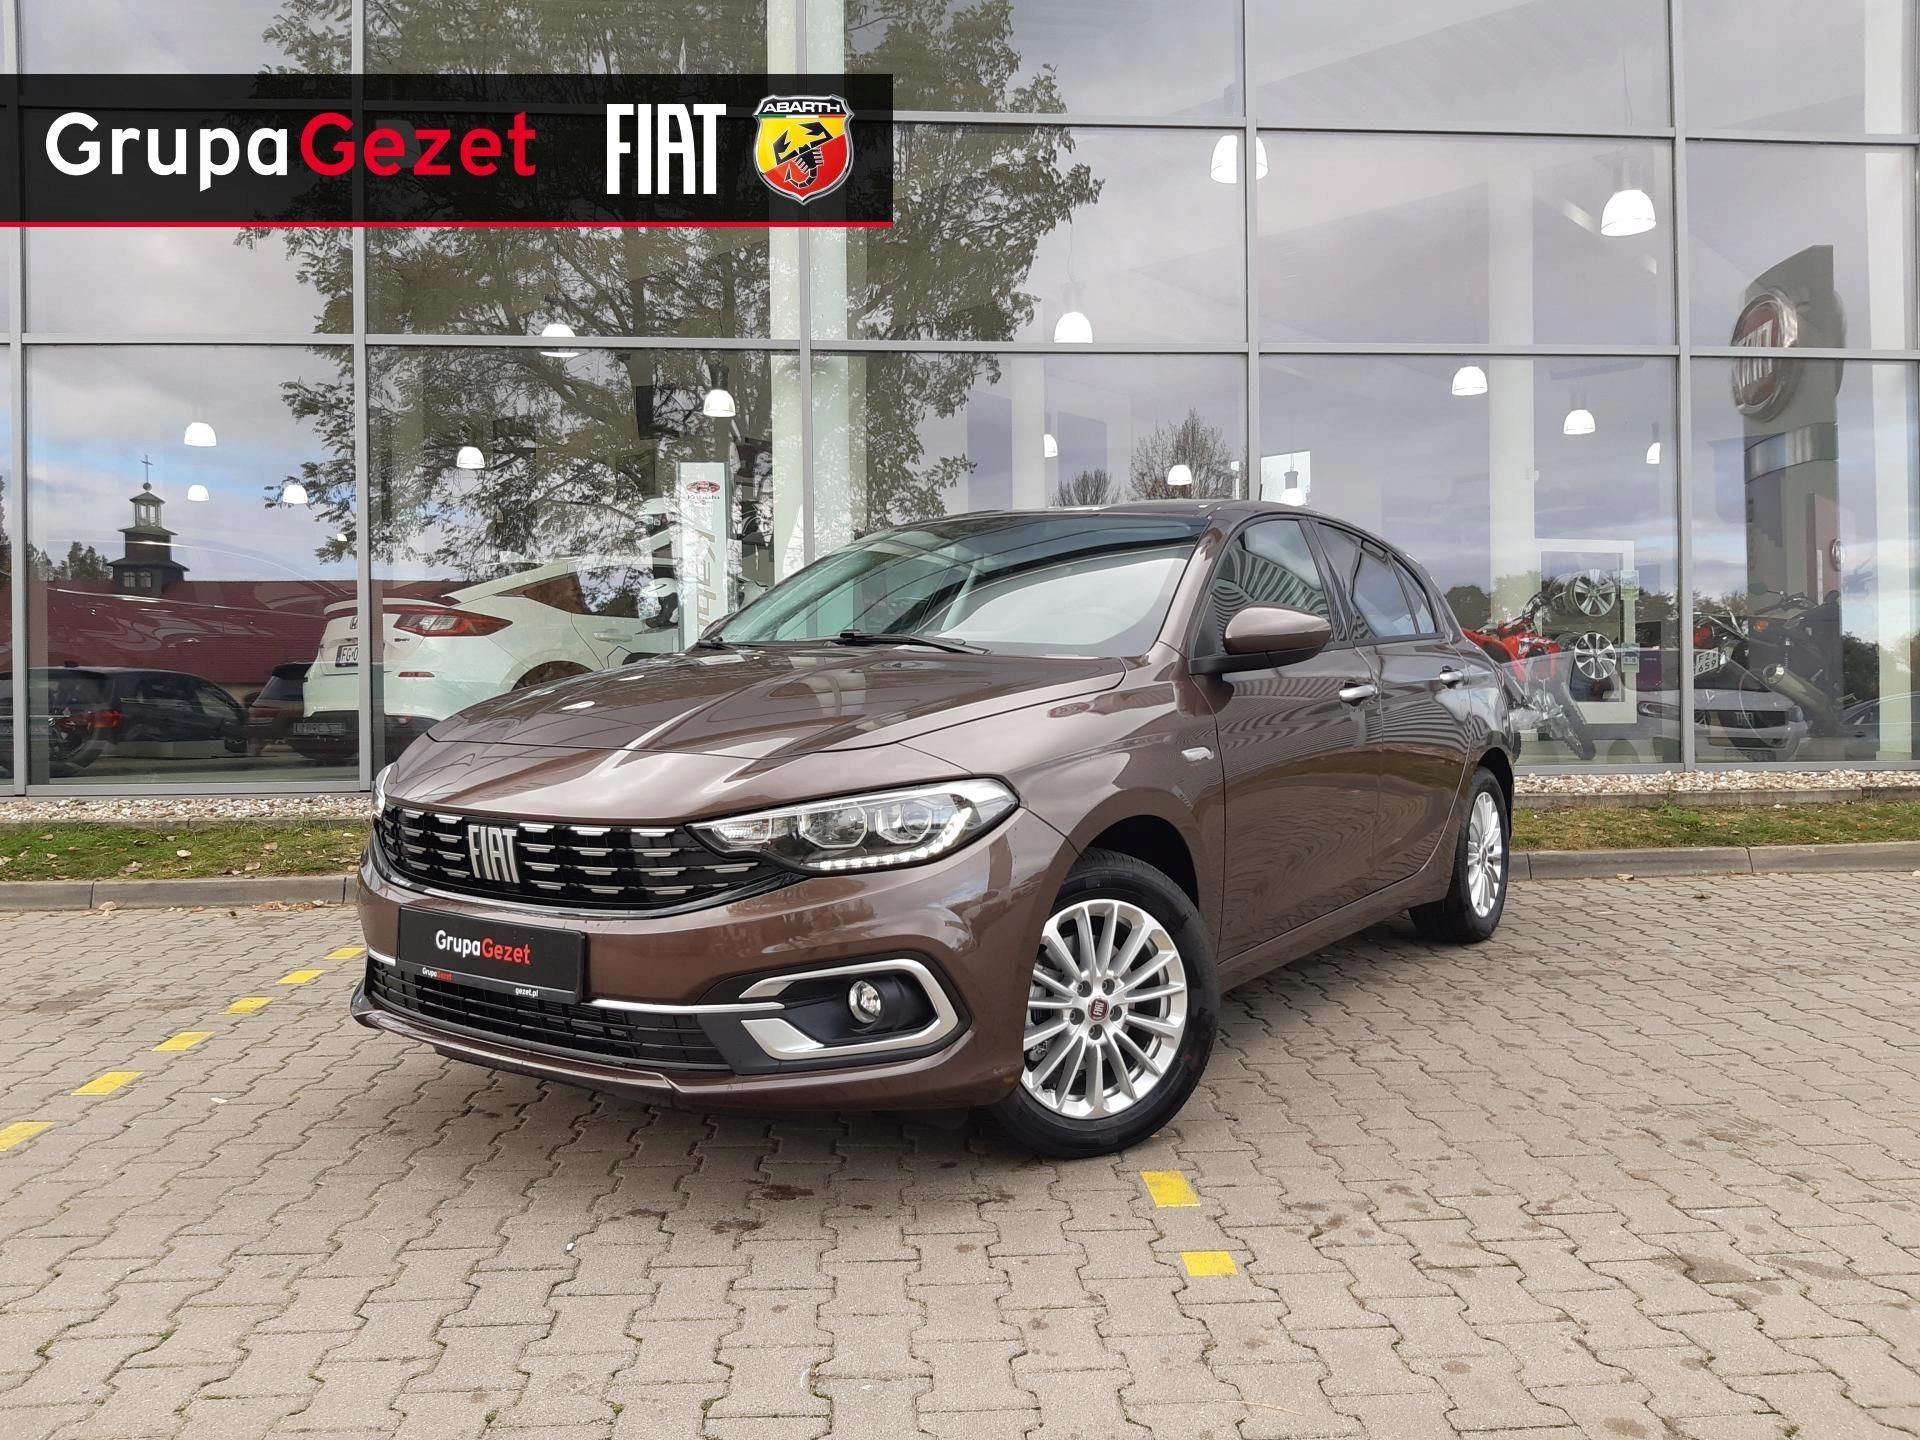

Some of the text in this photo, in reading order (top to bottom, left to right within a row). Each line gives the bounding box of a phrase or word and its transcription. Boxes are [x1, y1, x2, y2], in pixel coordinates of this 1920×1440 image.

[467, 824, 521, 884] FIAT
[515, 987, 539, 998] gezet.pl
[1092, 1000, 1105, 1016] FIAT
